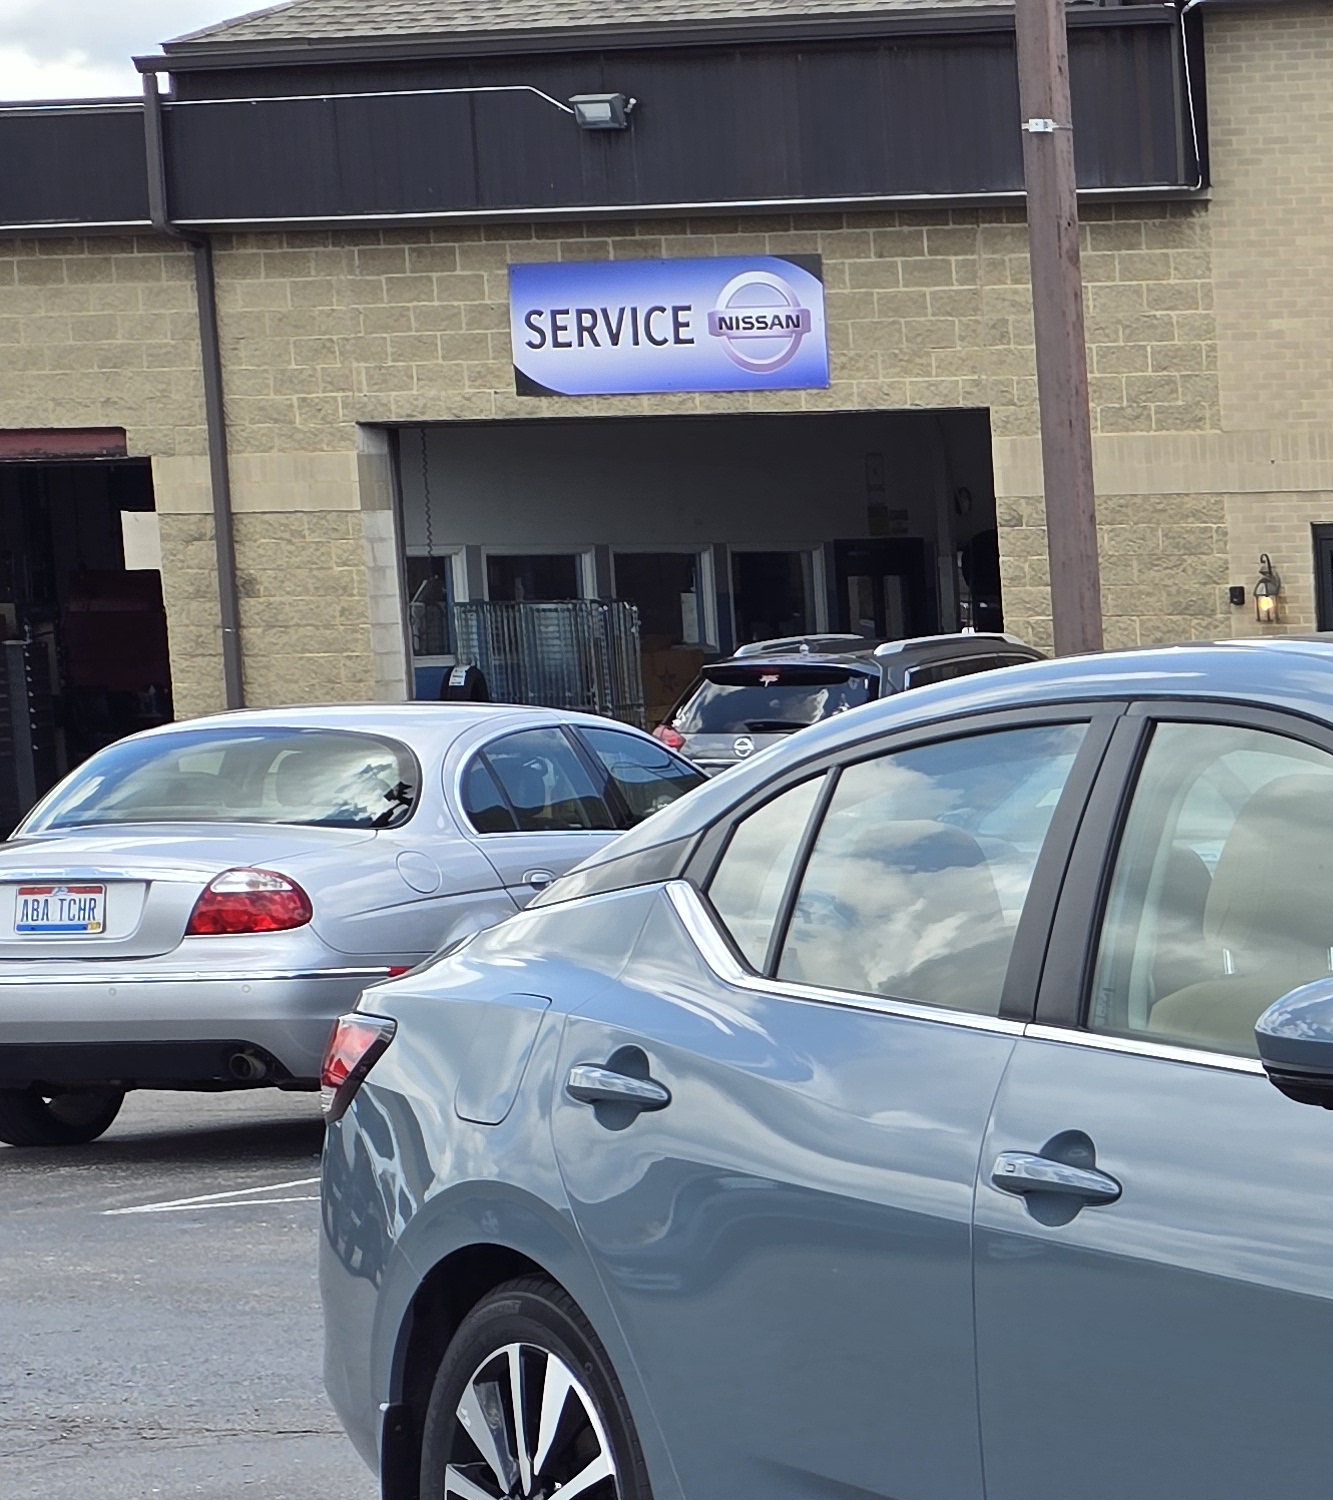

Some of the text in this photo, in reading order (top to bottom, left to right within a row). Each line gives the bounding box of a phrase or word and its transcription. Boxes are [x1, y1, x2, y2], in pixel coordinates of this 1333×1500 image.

[524, 304, 695, 350] SERVICE
[717, 313, 801, 331] NISSAN
[21, 897, 97, 922] ABA TCHR
